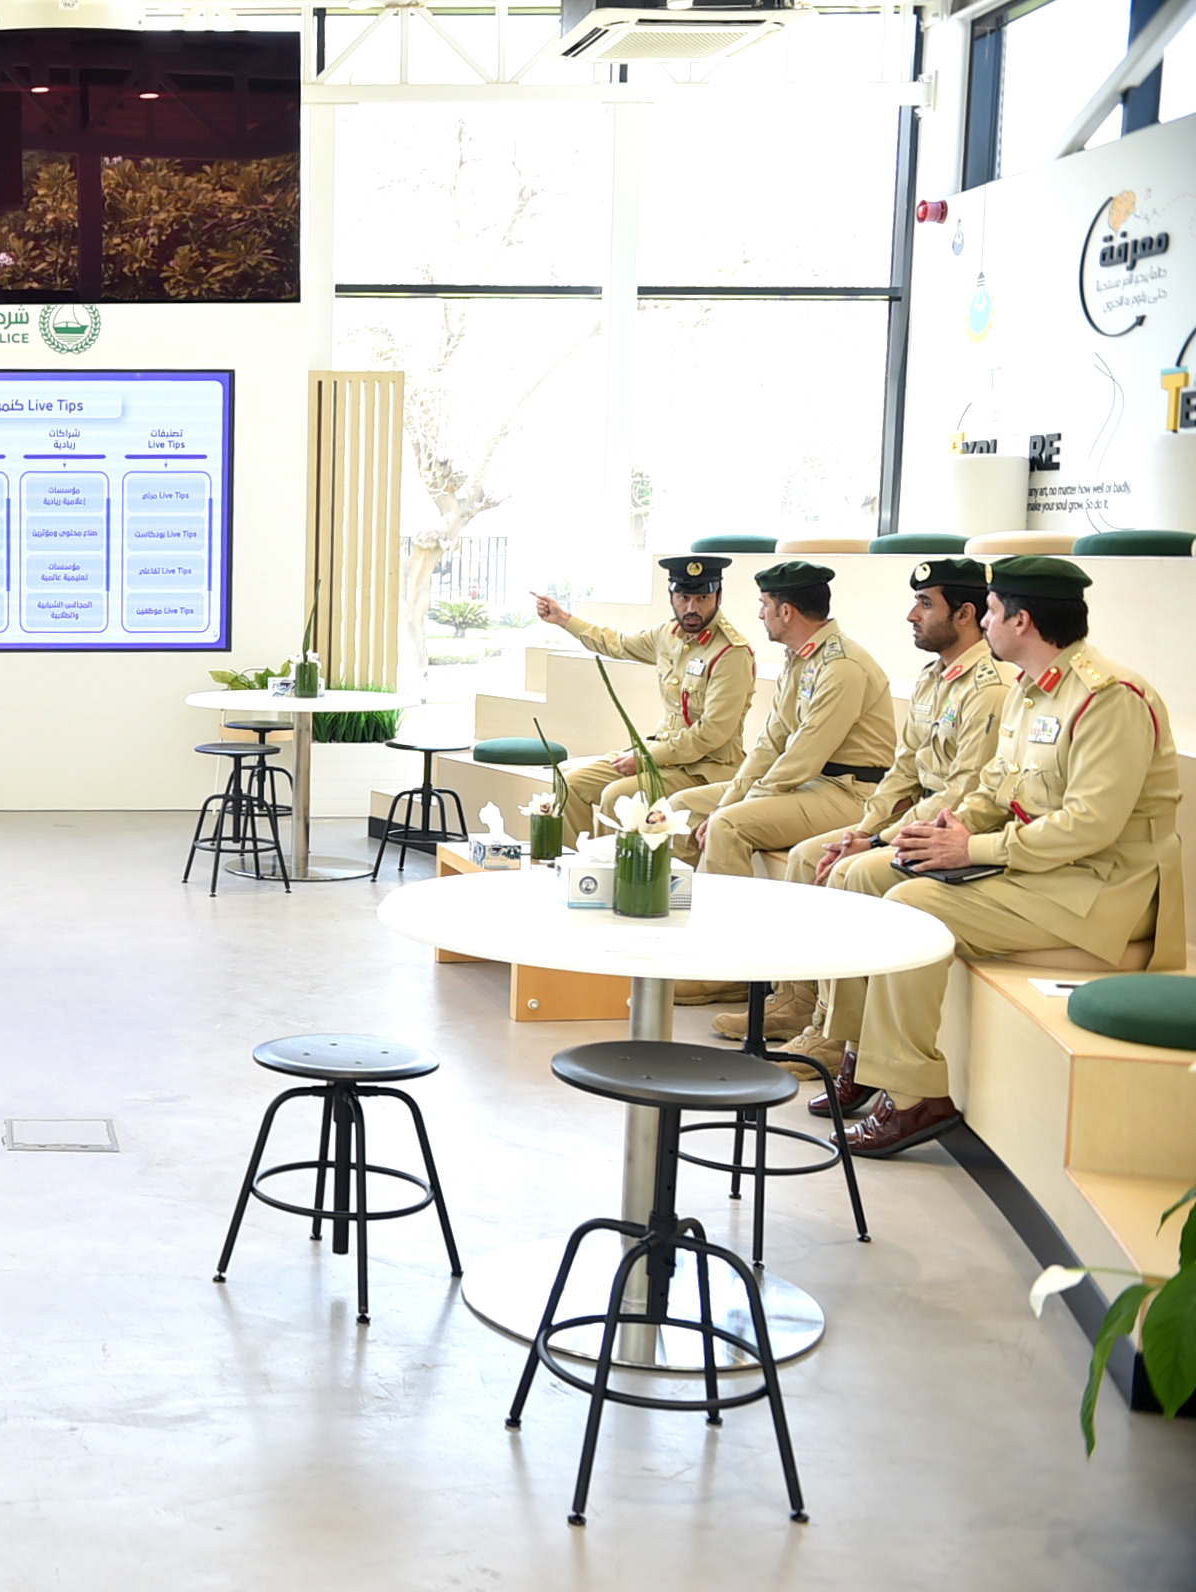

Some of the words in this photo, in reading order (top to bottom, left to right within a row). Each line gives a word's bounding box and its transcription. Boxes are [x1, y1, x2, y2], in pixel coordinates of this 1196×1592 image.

[1099, 231, 1170, 271] معرفة
[28, 399, 53, 411] Live
[57, 399, 83, 414] Tips
[49, 429, 80, 438] شراكات
[150, 429, 183, 439] تصنيفات
[54, 440, 76, 451] ريادية
[148, 440, 165, 449] Live
[168, 440, 185, 451] Tips
[1049, 488, 1057, 496] no
[1058, 485, 1076, 495] matter
[1078, 484, 1091, 494] how
[1093, 482, 1104, 493] well
[1105, 484, 1112, 493] or
[176, 492, 189, 501] Tips
[1041, 502, 1055, 513] your
[1056, 499, 1067, 511] soul
[1086, 499, 1093, 509] So
[1094, 498, 1102, 509] do
[183, 531, 197, 539] Tips
[162, 567, 176, 575] Live
[178, 567, 191, 576] Tips
[179, 608, 194, 616] Tips
